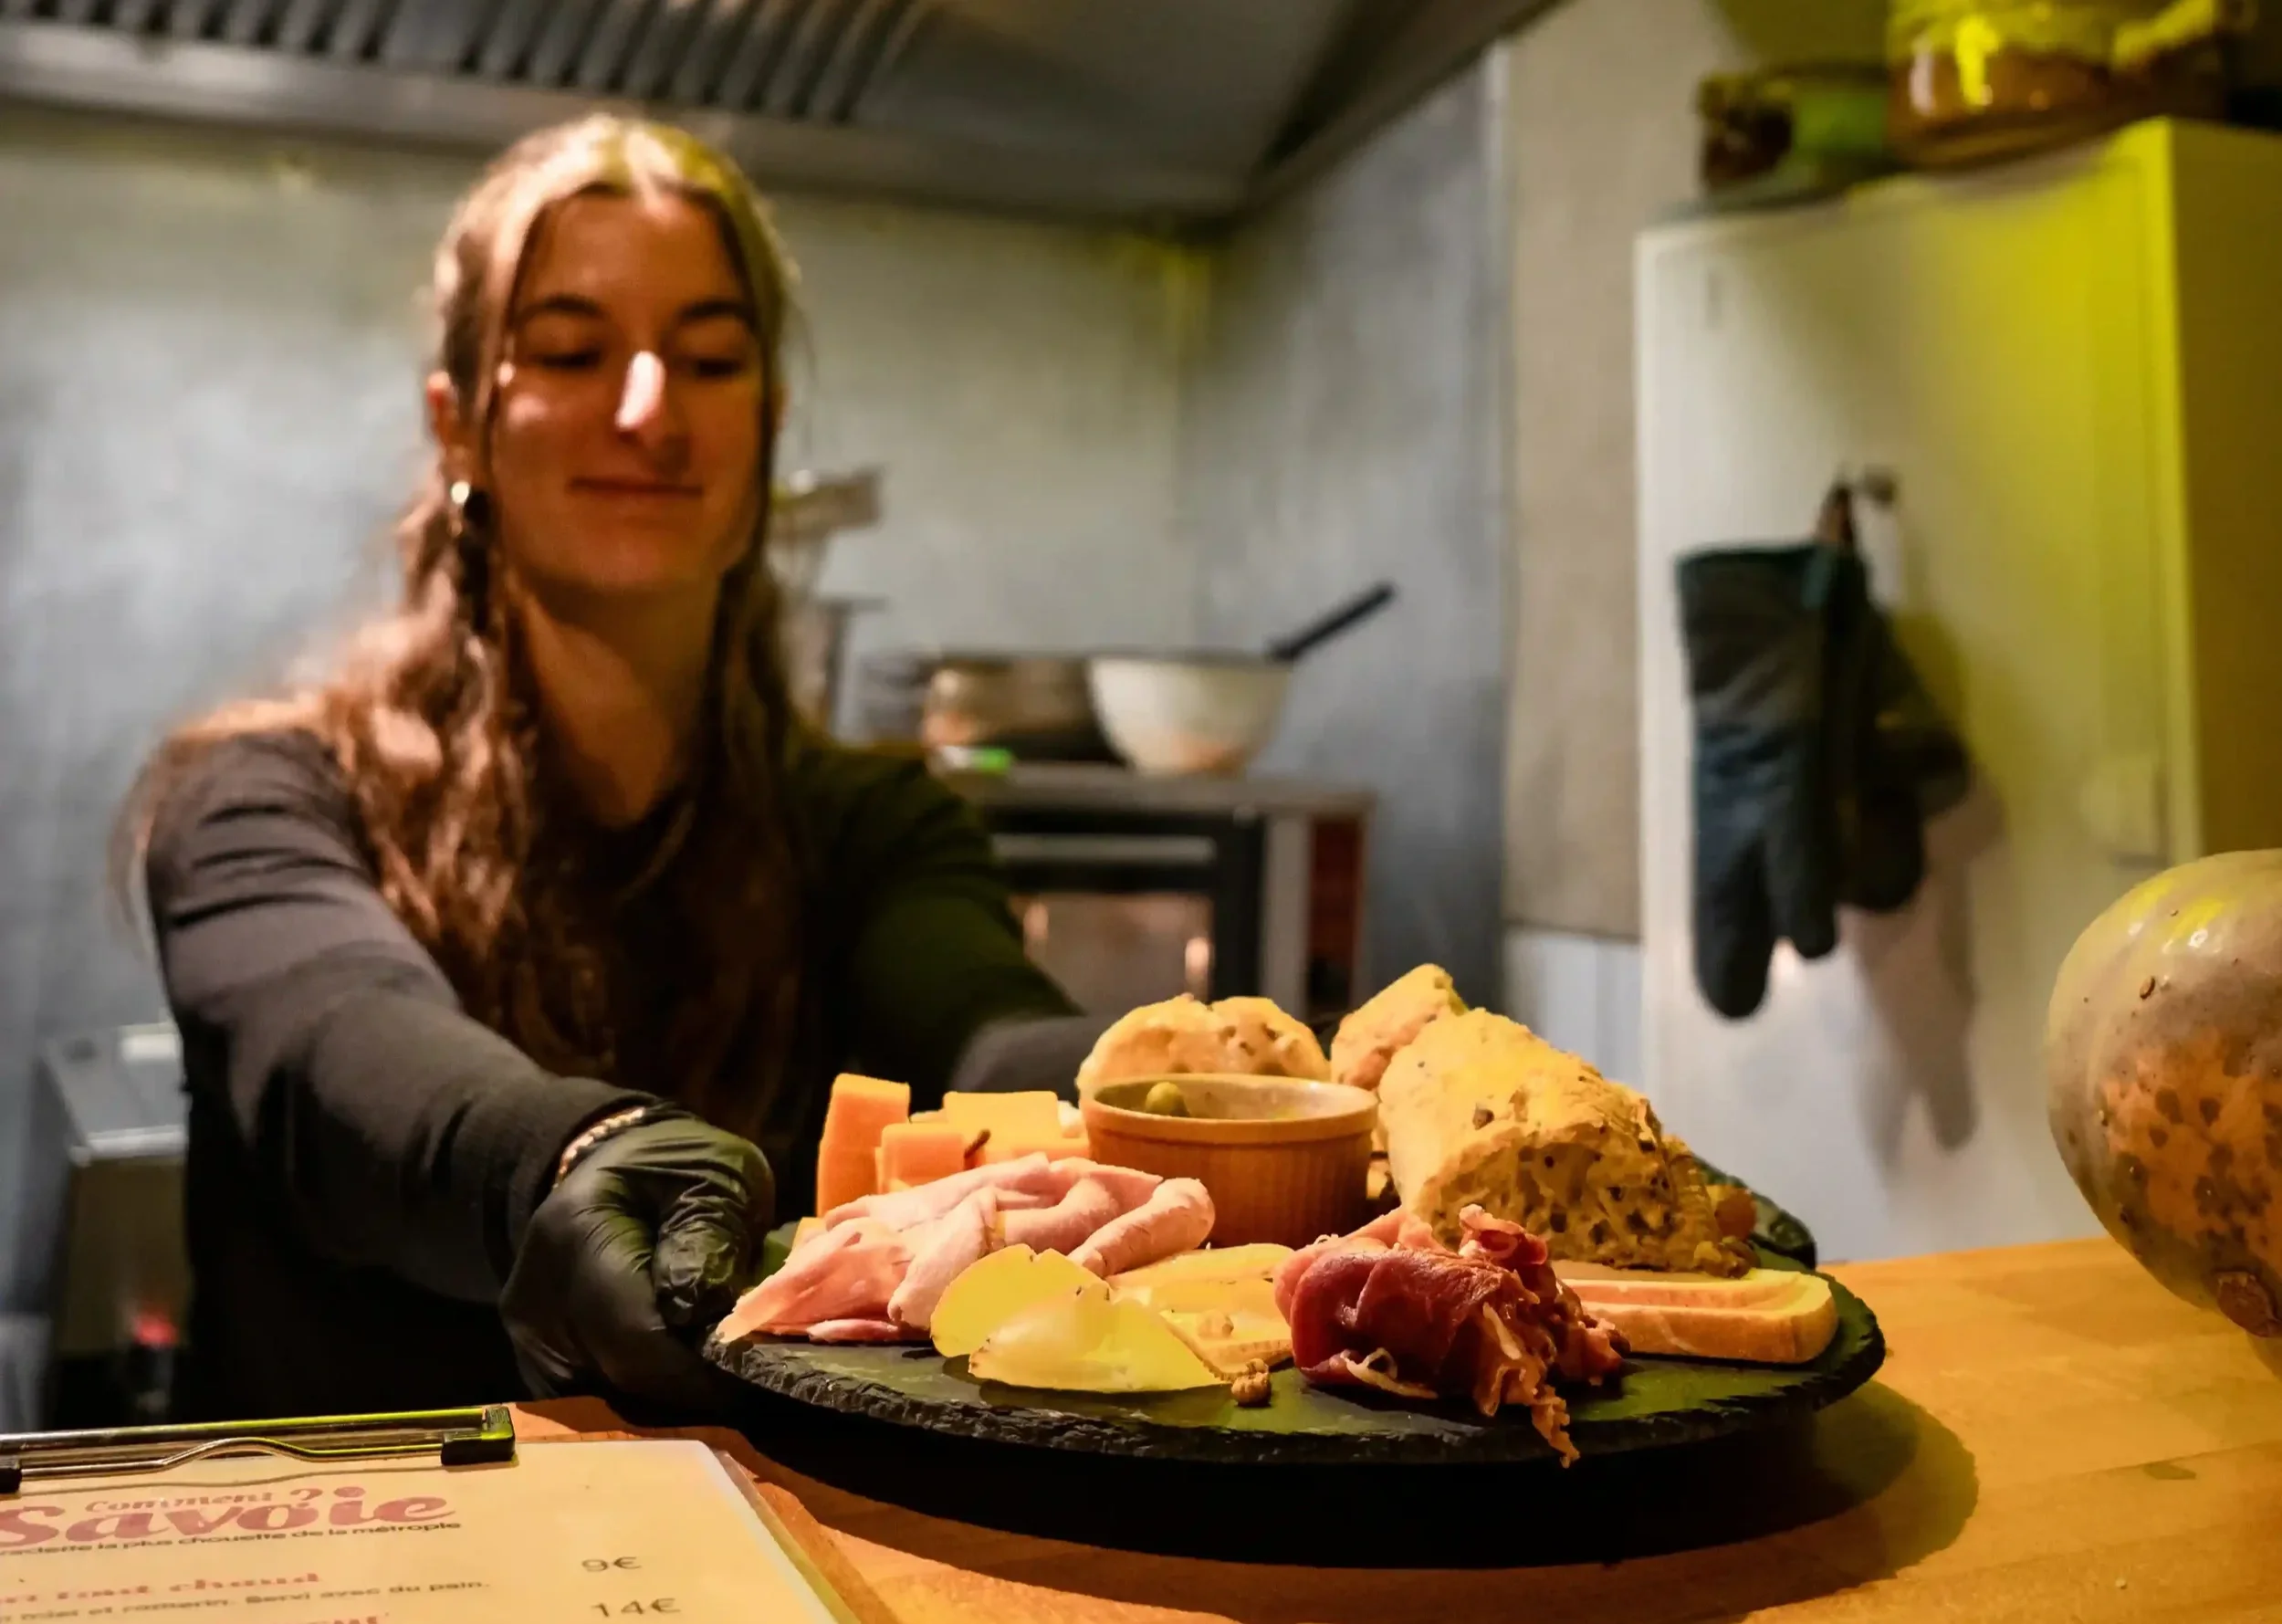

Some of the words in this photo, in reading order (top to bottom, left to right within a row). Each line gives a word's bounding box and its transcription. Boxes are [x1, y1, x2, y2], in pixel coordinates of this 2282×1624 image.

[84, 1490, 273, 1513] Comment
[290, 1488, 323, 1507] ?
[0, 1486, 456, 1547] Savoie
[98, 1542, 118, 1550] la
[122, 1540, 173, 1550] plus
[178, 1534, 287, 1545] chouette
[291, 1530, 324, 1538] de
[329, 1528, 348, 1536] la
[581, 1556, 642, 1572] 9€
[89, 1607, 113, 1616] et
[245, 1591, 310, 1604] Servi
[319, 1587, 382, 1599] avec
[389, 1583, 421, 1593] du
[590, 1598, 682, 1618] 14€
